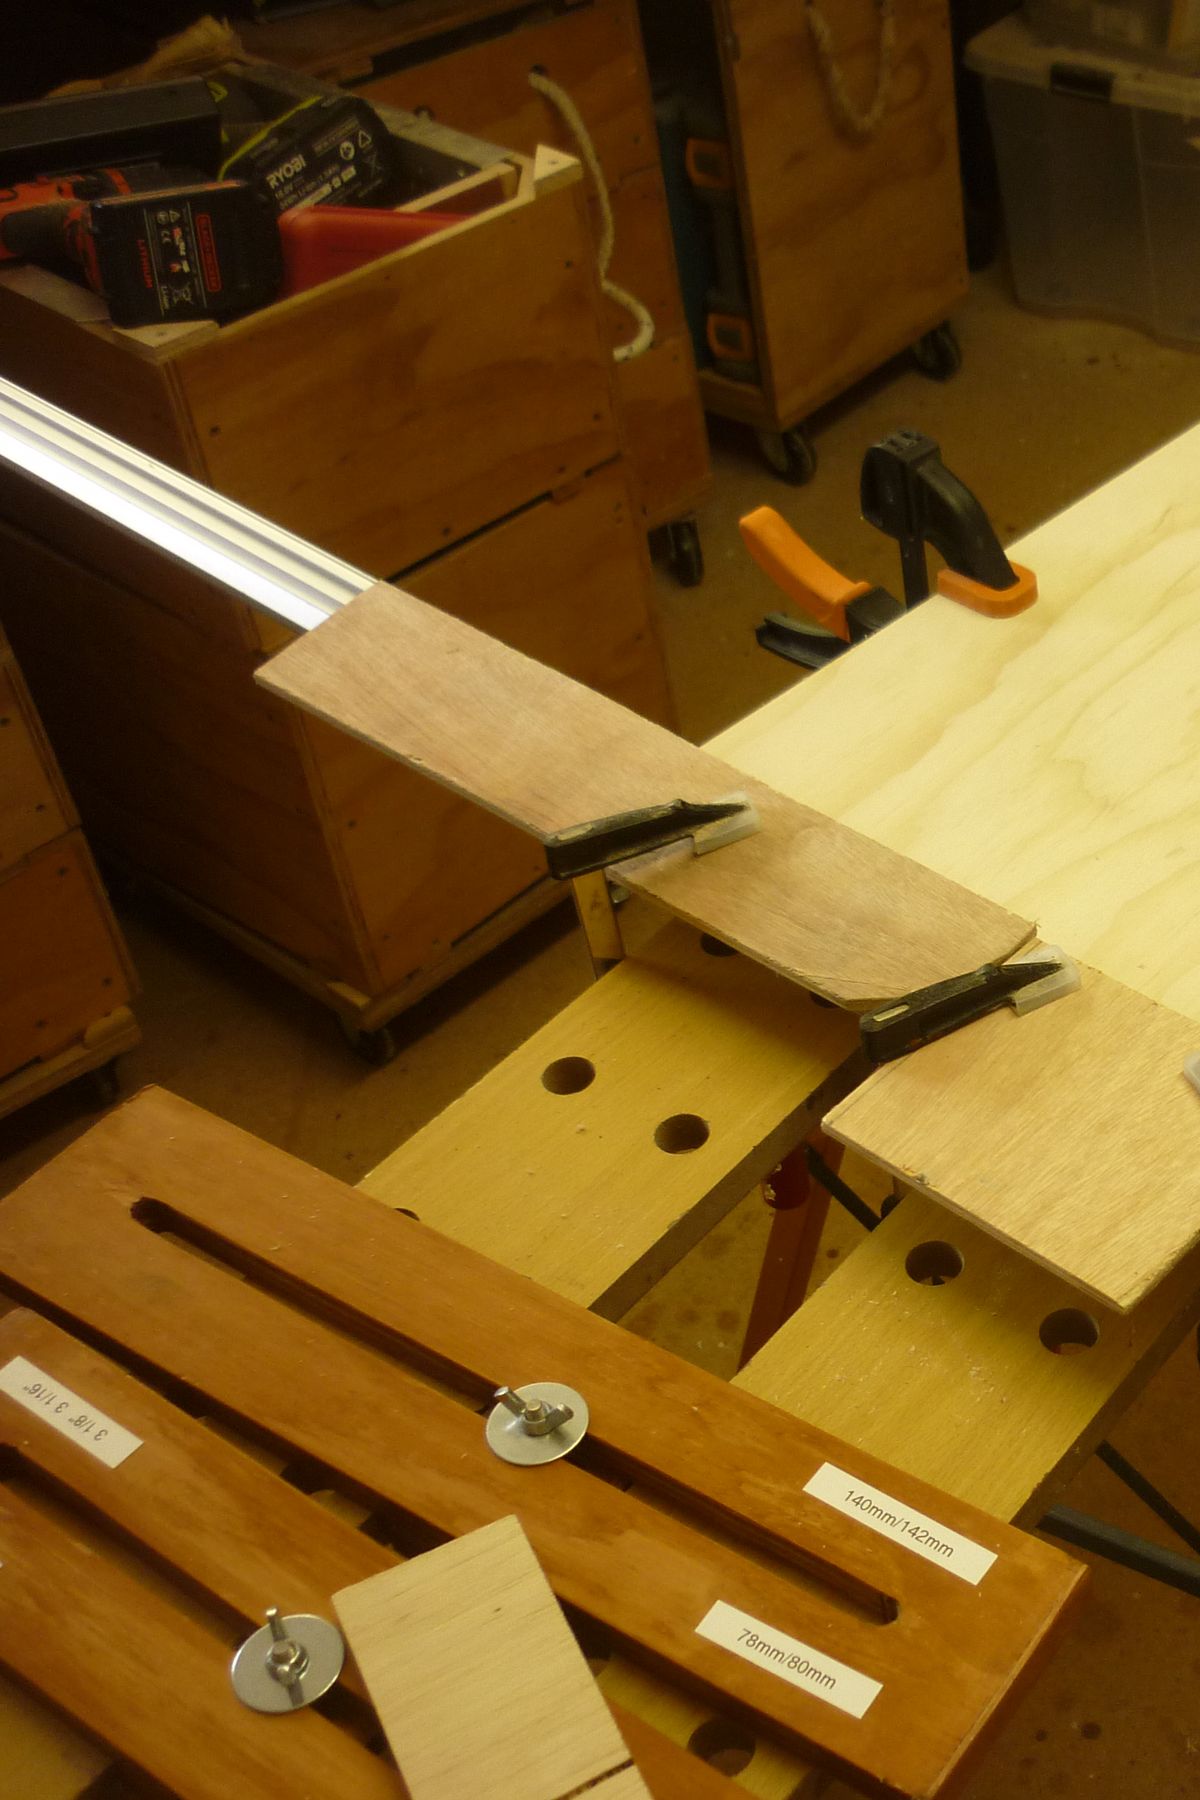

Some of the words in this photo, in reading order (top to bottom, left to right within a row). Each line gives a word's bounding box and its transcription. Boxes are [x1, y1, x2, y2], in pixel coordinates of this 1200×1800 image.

[266, 153, 307, 190] RYOBI
[55, 1402, 69, 1413] 3
[94, 1429, 108, 1441] 3
[844, 1489, 954, 1558] 140mm/142mm
[736, 1628, 837, 1690] 78mm/80mm
